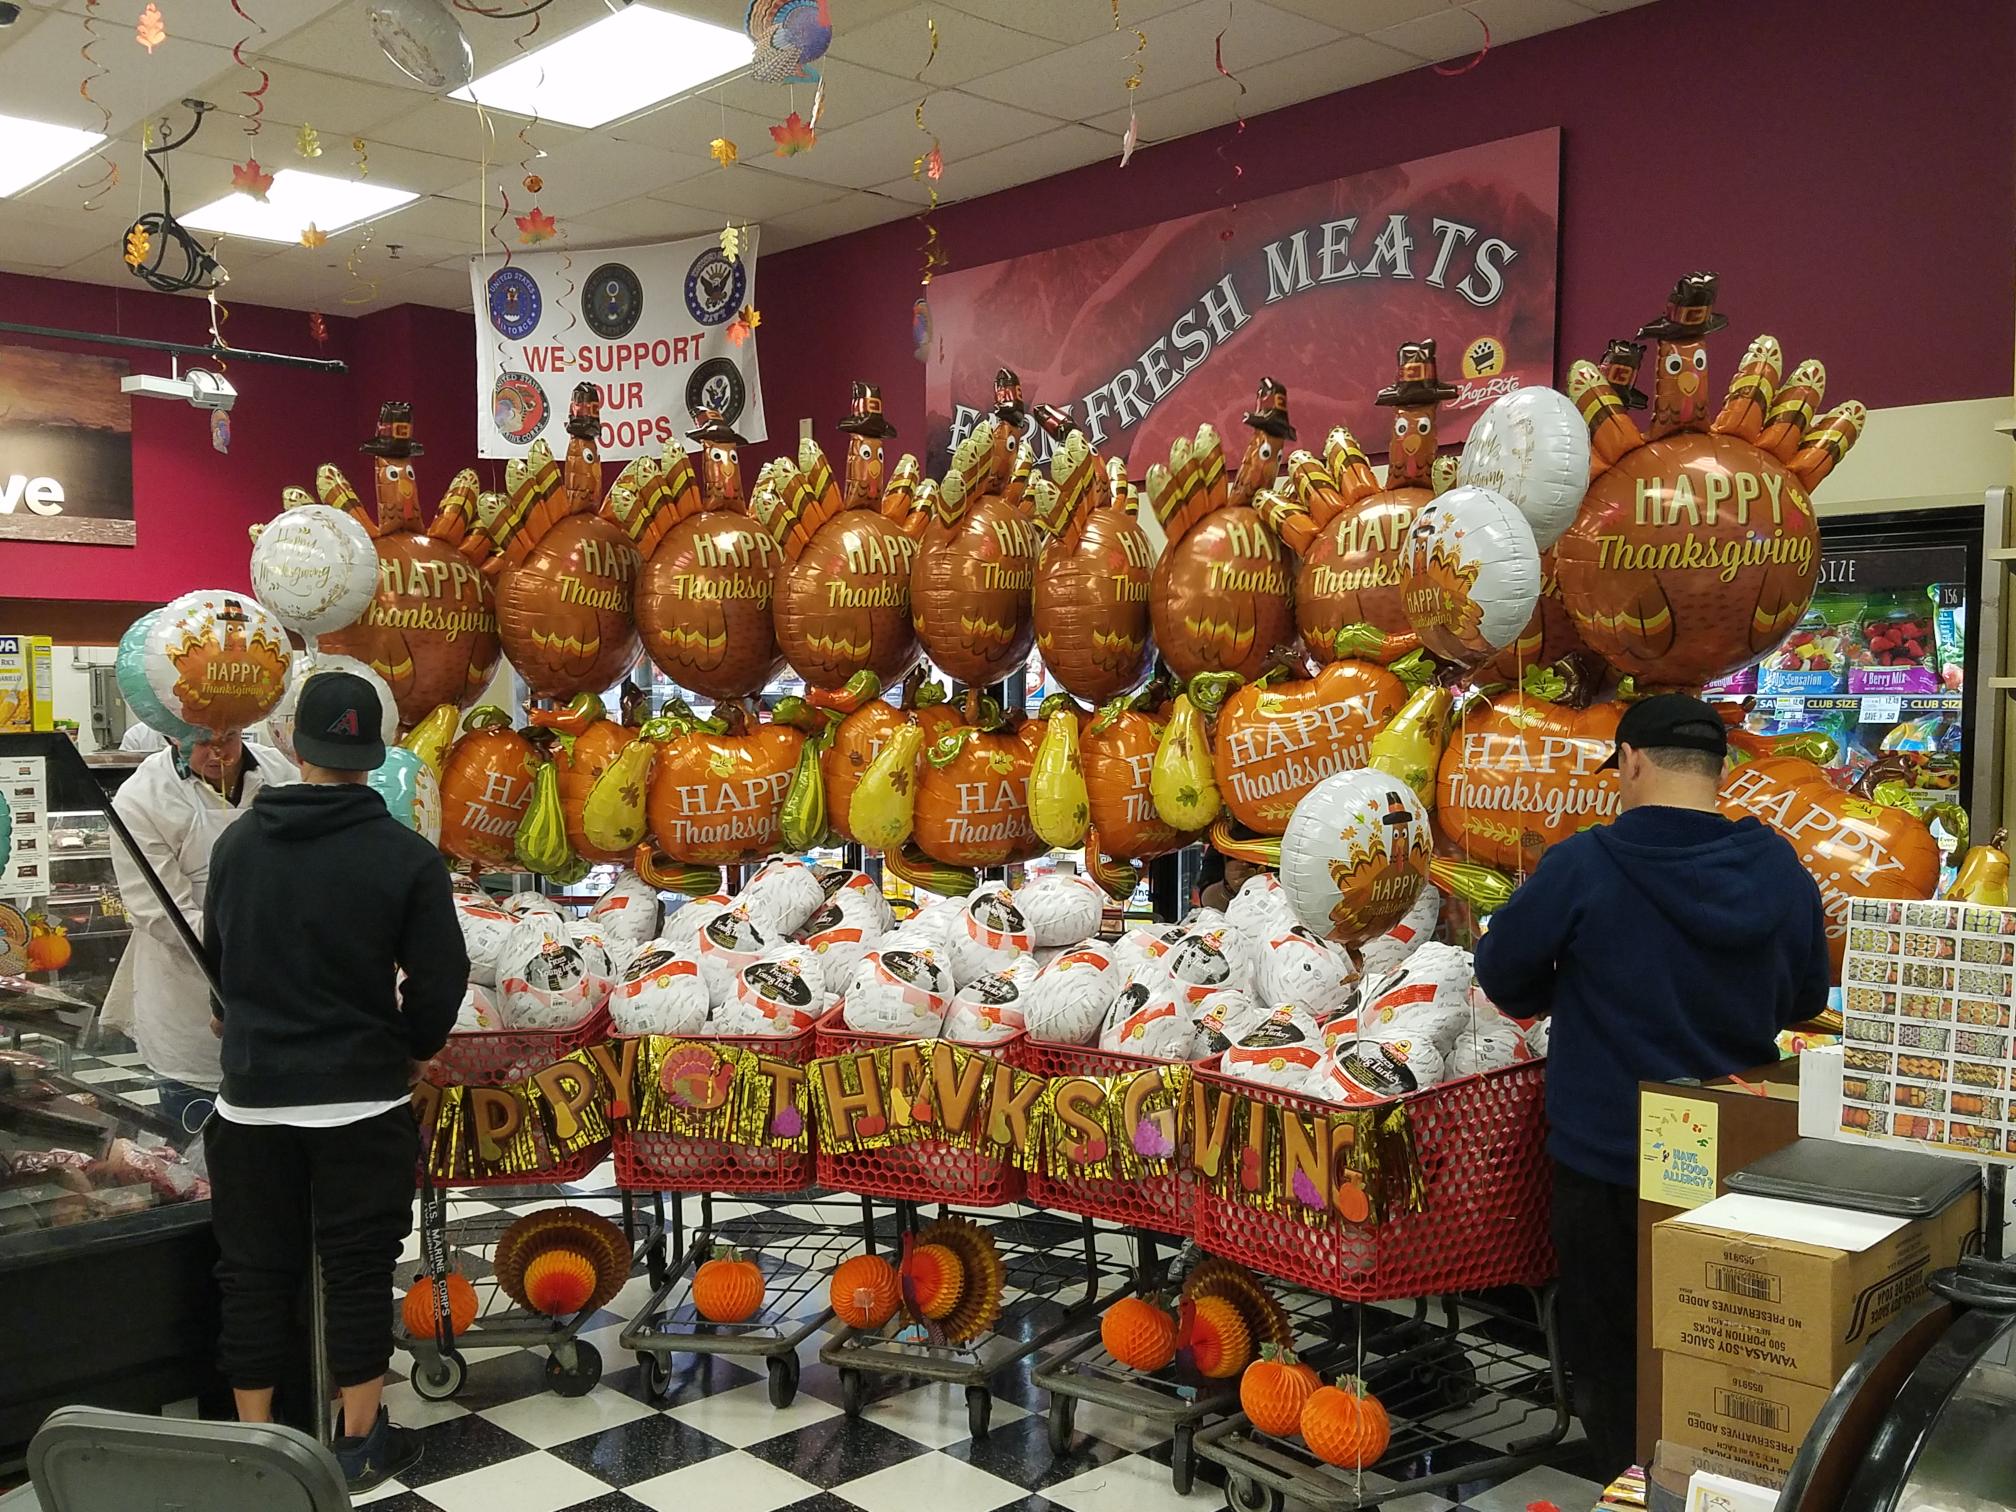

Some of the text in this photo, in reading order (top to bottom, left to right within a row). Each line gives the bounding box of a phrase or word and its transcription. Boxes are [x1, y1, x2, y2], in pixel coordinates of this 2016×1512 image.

[489, 272, 536, 295] UNITED STATES
[1082, 273, 1253, 446] FRESH
[1263, 214, 1519, 306] MEATS
[523, 345, 565, 373] WE
[578, 333, 705, 373] SUPPORT
[1635, 471, 1785, 527] HAPPY
[1337, 507, 1424, 556] HAP
[1595, 529, 1814, 583] Thanksgiving
[380, 557, 483, 603] HAPPY
[1818, 558, 1856, 584] SIZE
[1406, 586, 1441, 613] HAPPY
[1943, 588, 1958, 604] 156
[206, 661, 262, 684] HAPPY
[1869, 673, 1889, 686] Berry
[1807, 699, 1834, 709] CLUB
[1835, 699, 1858, 709] SIZE
[1911, 700, 1937, 709] CLUB
[1226, 690, 1379, 768] HAPPY
[1719, 768, 1906, 889] HAPPY
[1371, 873, 1418, 902] HAPPY
[755, 967, 800, 998] Young Turkey
[769, 968, 794, 984] Frozen
[1372, 1059, 1402, 1085] Turkey
[410, 1038, 640, 1160] APPY
[1672, 1161, 1709, 1177] A FOOD
[1673, 1148, 1698, 1164] HAVE
[428, 1201, 439, 1223] U.S.
[431, 1228, 445, 1274] MARINE
[1723, 1251, 1755, 1266] 055916
[438, 1280, 451, 1317] CORPS
[1677, 1293, 1803, 1329] NO PRESERVATIVES ADDED
[1679, 1330, 1798, 1370] YAMASA SOY SAUCE
[1692, 1321, 1786, 1352] 500 PORTION PACKS
[1732, 1377, 1764, 1393] 055916
[1686, 1417, 1795, 1454] PRESERVATIVES ADDED
[1716, 1441, 1738, 1455] EACH
